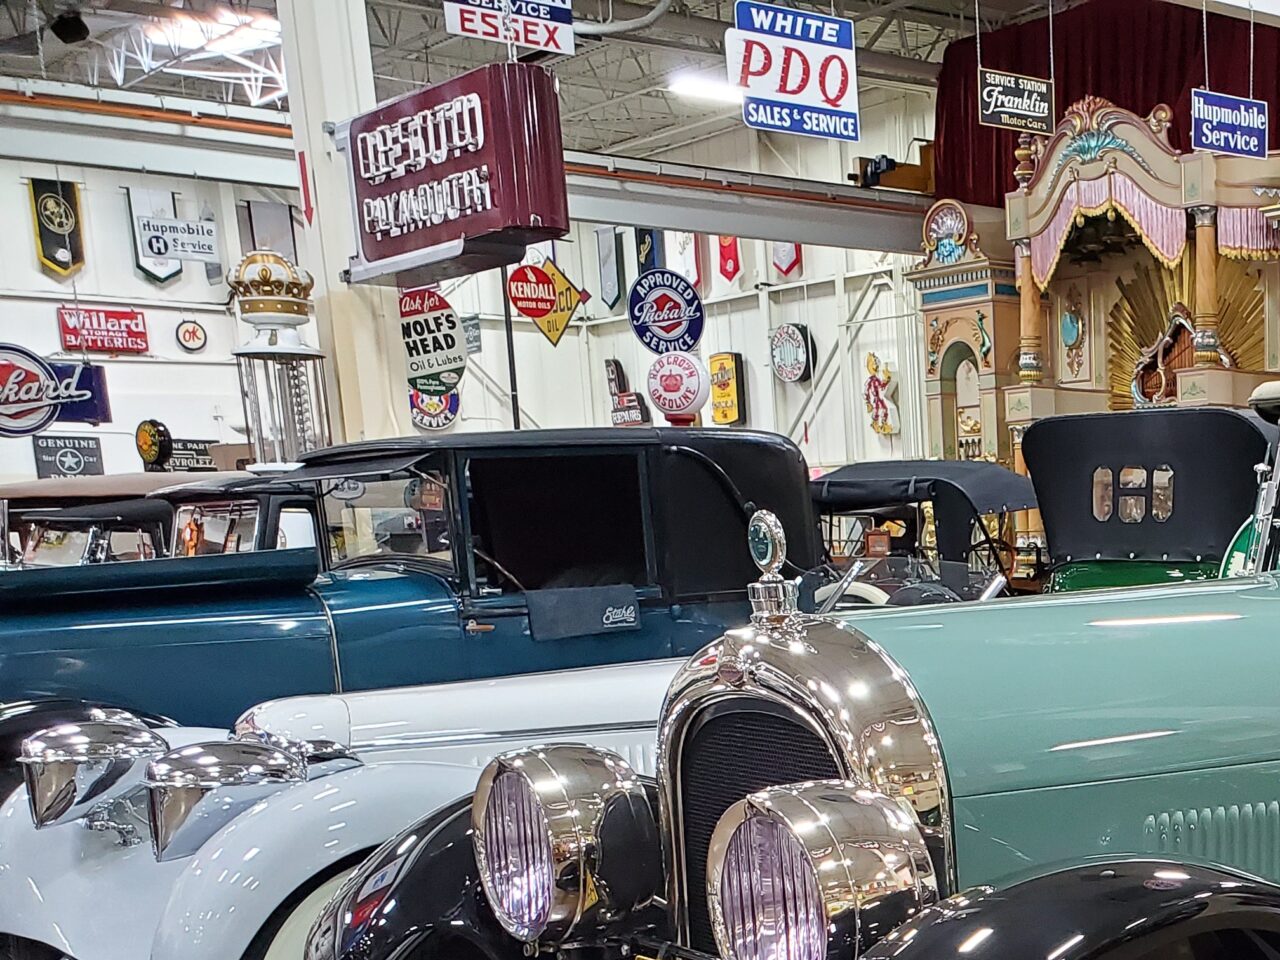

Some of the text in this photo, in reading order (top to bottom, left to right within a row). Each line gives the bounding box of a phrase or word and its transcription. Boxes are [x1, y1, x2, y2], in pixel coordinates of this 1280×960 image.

[459, 8, 562, 50] ESSEX
[750, 7, 840, 43] WHITE
[738, 38, 849, 108] PDQ
[985, 73, 1047, 94] SERVICE STATION
[982, 86, 1049, 115] Franklin
[748, 103, 856, 137] SALES & SERVICE
[1194, 96, 1266, 130] Hupmobile
[1201, 122, 1259, 152] Service
[142, 218, 214, 237] Hupmobile
[172, 238, 213, 252] Service
[510, 281, 555, 300] KENDALL
[636, 273, 694, 300] APPROVED
[401, 291, 440, 312] Ask for
[517, 300, 550, 310] MOTOR OILS
[61, 310, 146, 333] Willard
[634, 299, 700, 327] Packard
[81, 329, 128, 337] STORAGE
[182, 327, 201, 343] OK
[547, 319, 559, 333] OIL
[66, 334, 147, 349] BATTERIES
[405, 333, 456, 358] HEAD
[643, 332, 695, 352] SERVICE
[410, 359, 426, 372] Oil
[436, 354, 463, 368] Lubes
[667, 356, 696, 378] CROWN
[0, 365, 92, 408] kard
[652, 386, 696, 409] GASOLINE
[38, 438, 97, 449] GENUINE
[166, 458, 213, 468] EVROLET
